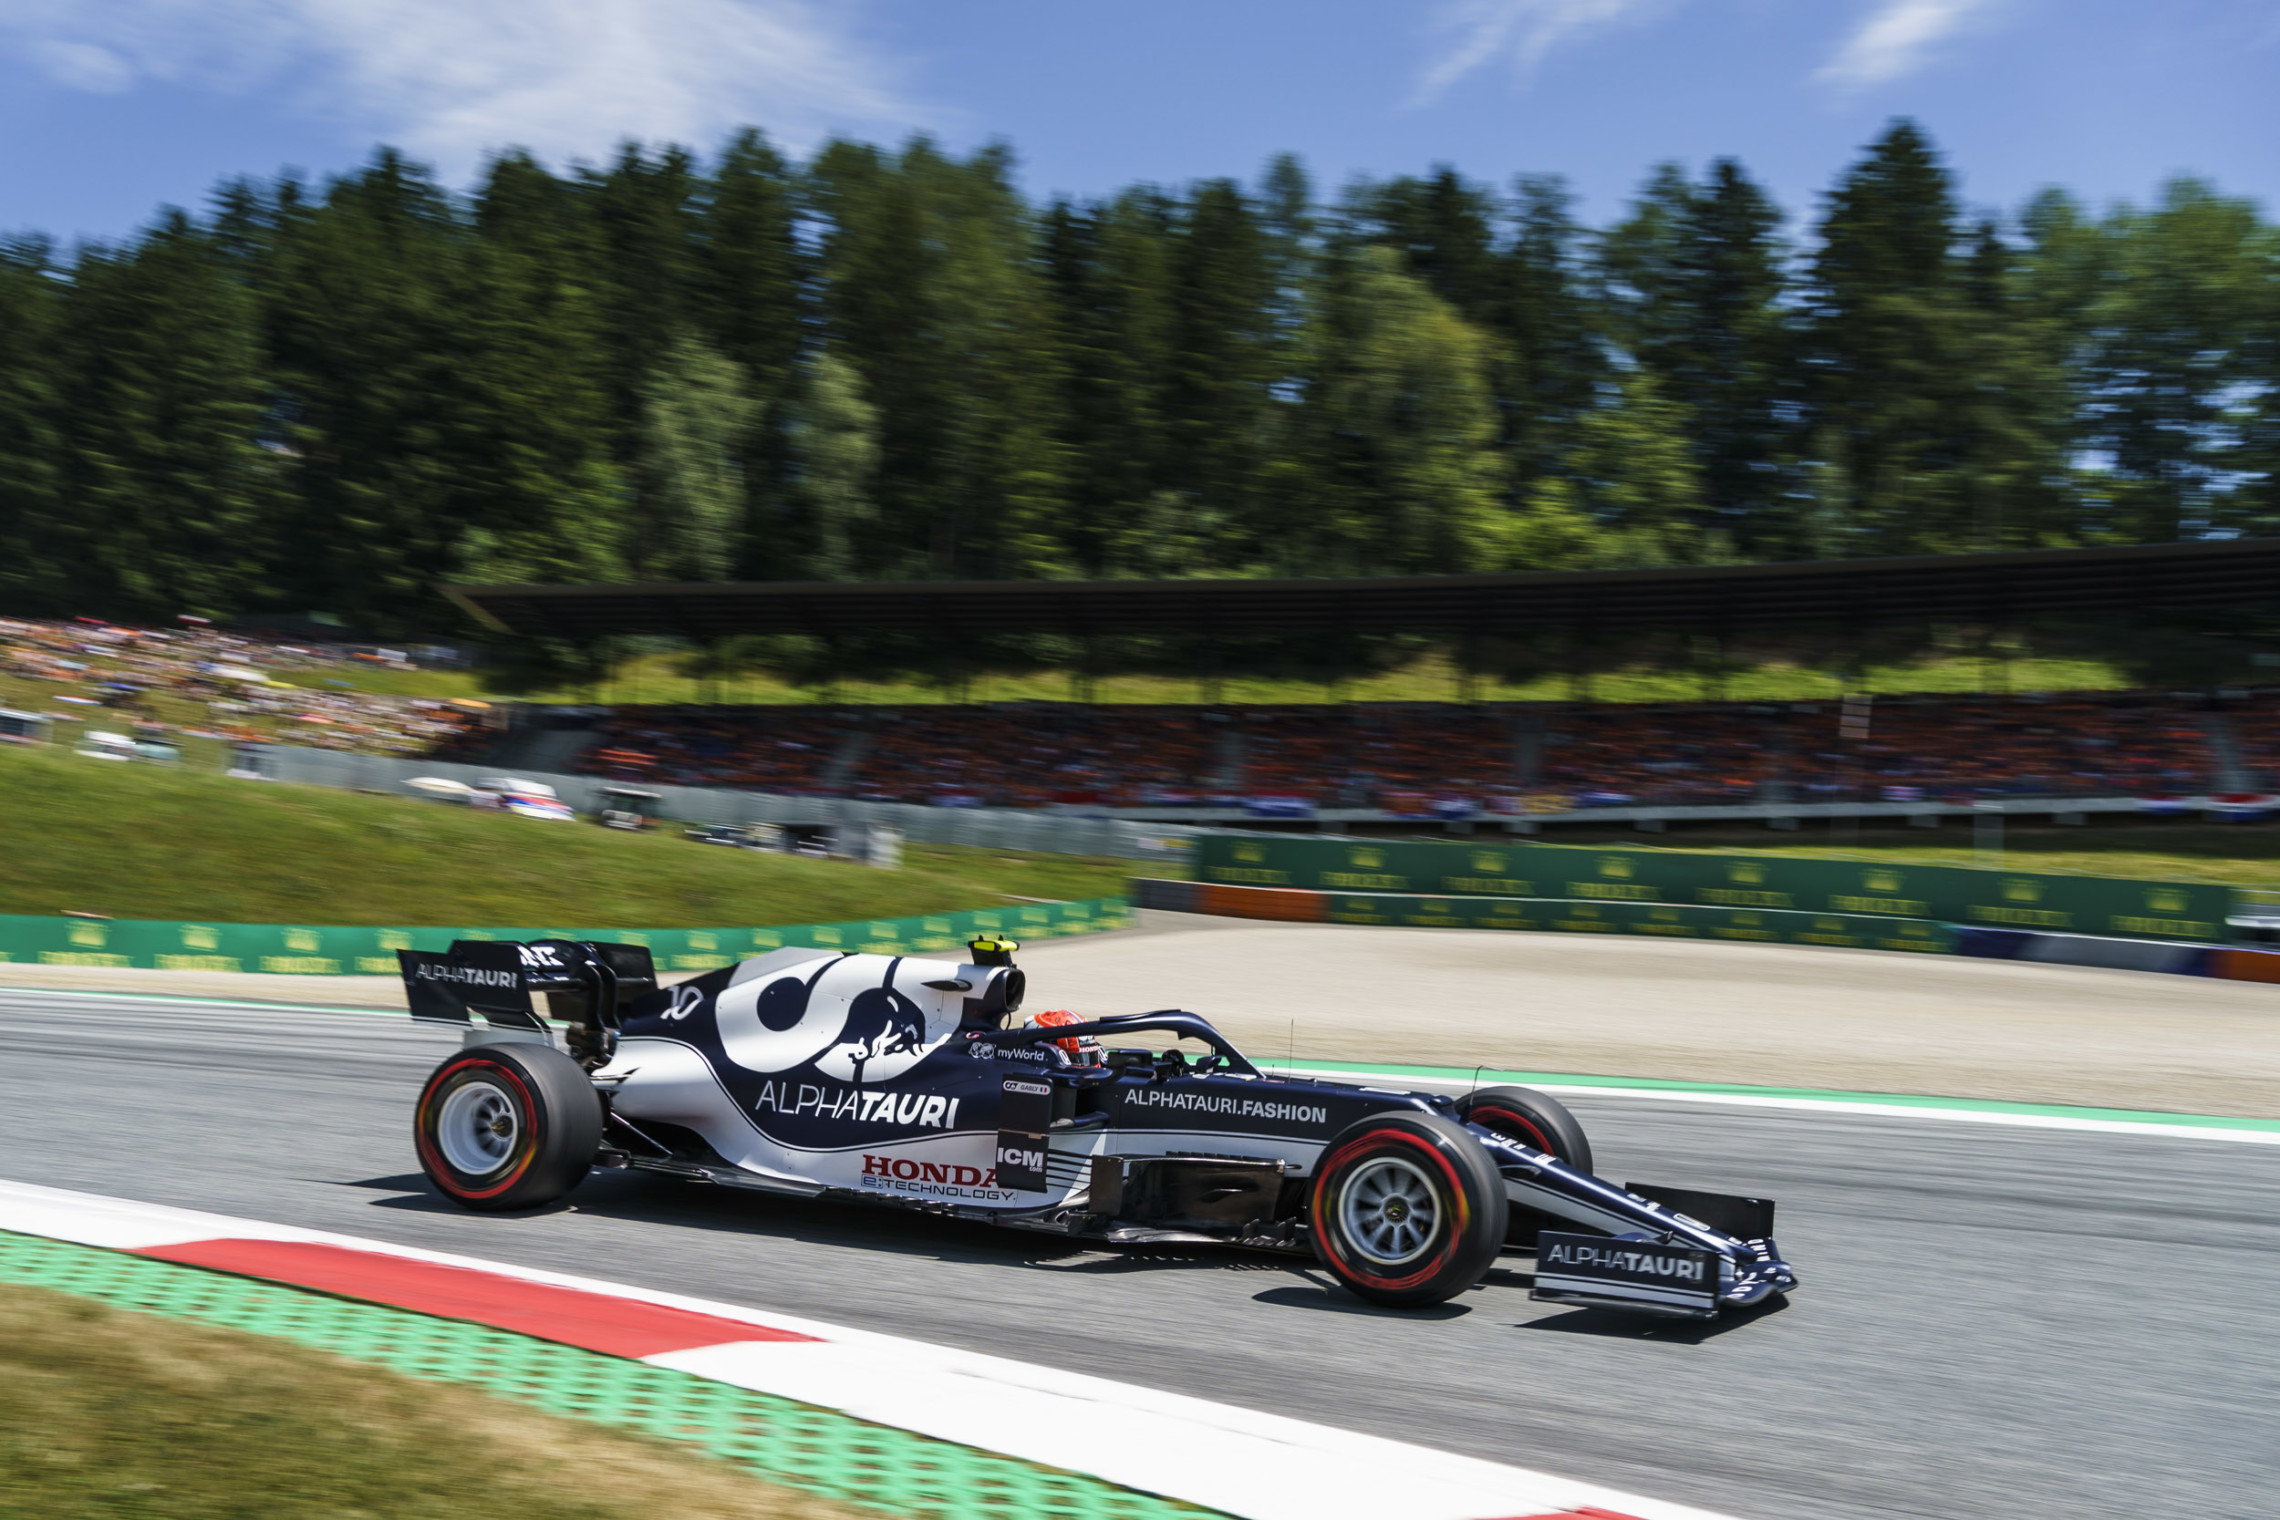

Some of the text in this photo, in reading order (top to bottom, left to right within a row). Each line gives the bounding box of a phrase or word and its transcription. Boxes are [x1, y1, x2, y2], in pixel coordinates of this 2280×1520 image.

[415, 963, 518, 989] ALPHATAURI
[660, 985, 704, 1020] 10
[997, 1048, 1045, 1062] myWorld
[1020, 1084, 1039, 1093] GASLY
[755, 1080, 960, 1130] ALPHATAURI
[1124, 1089, 1327, 1124] ALPHATAURI.FASHION
[996, 1147, 1044, 1168] ICM
[1547, 1244, 1705, 1281] ALPHATAURI
